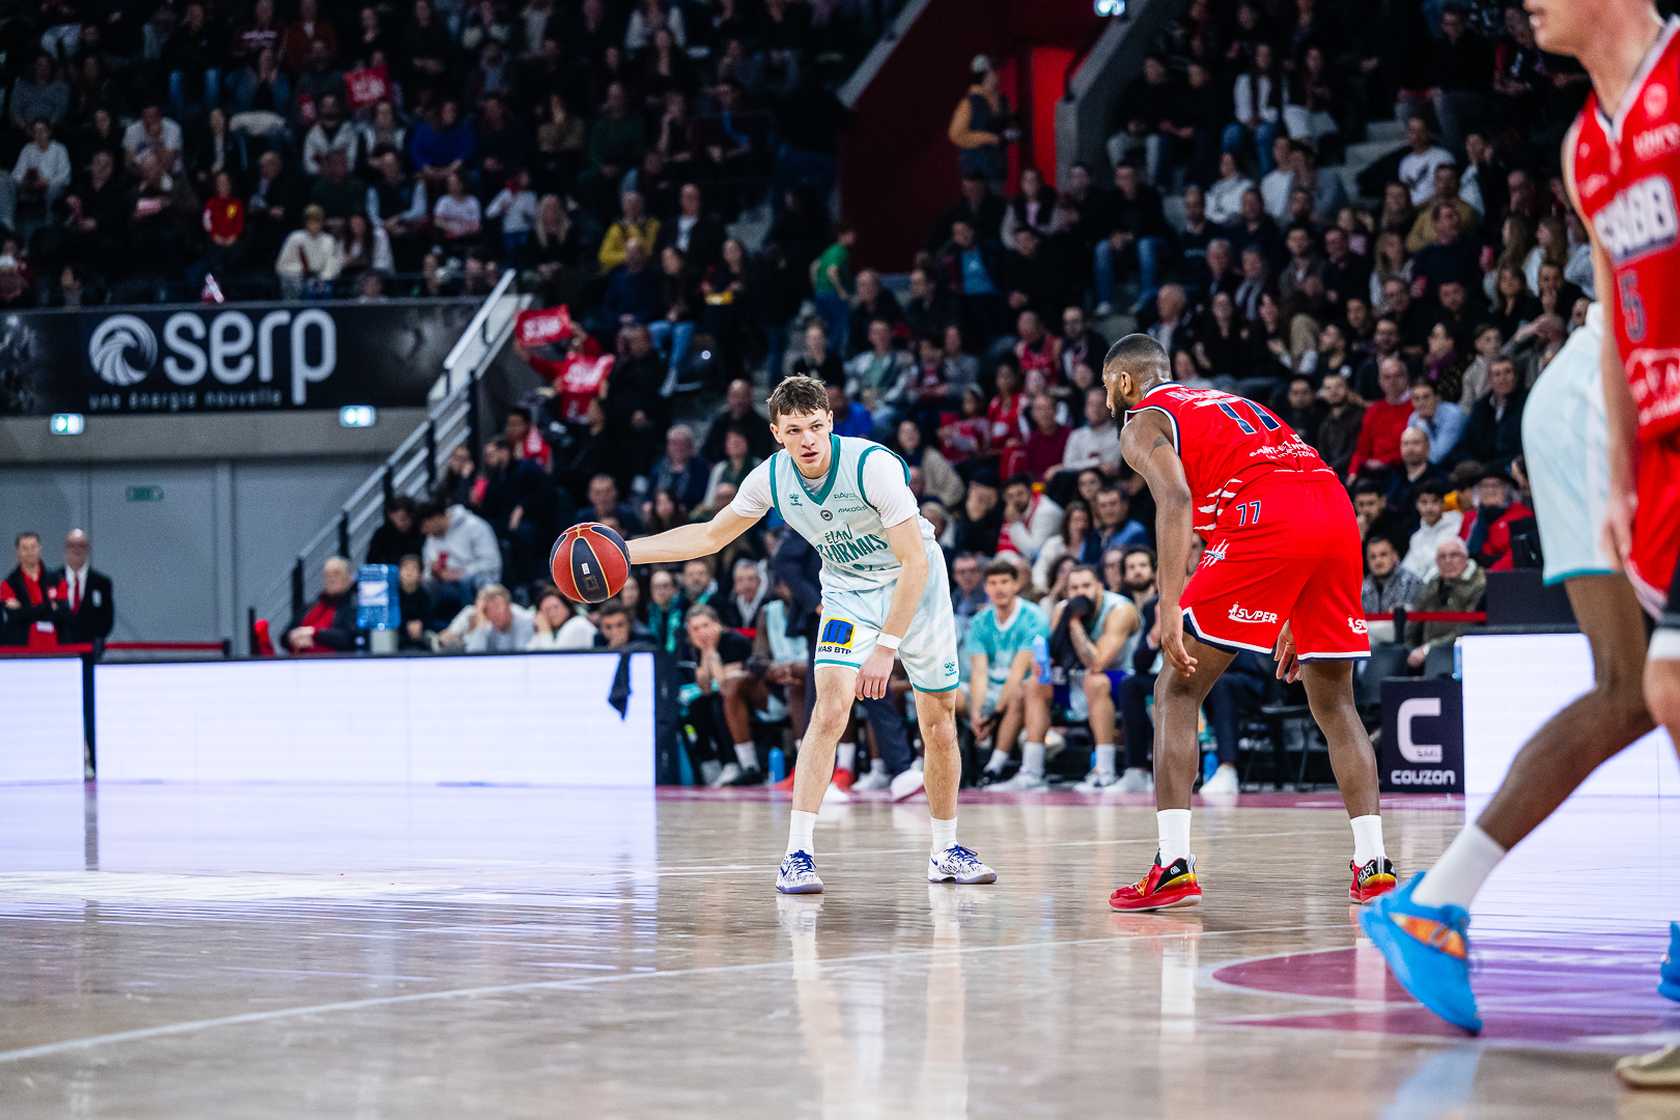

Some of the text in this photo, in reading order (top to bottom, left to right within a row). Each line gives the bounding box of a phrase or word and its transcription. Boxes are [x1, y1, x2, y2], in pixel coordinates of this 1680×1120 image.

[1617, 269, 1647, 343] 5
[163, 309, 337, 405] serp
[89, 393, 121, 409] une
[1235, 500, 1261, 527] 77
[834, 646, 852, 655] BTP
